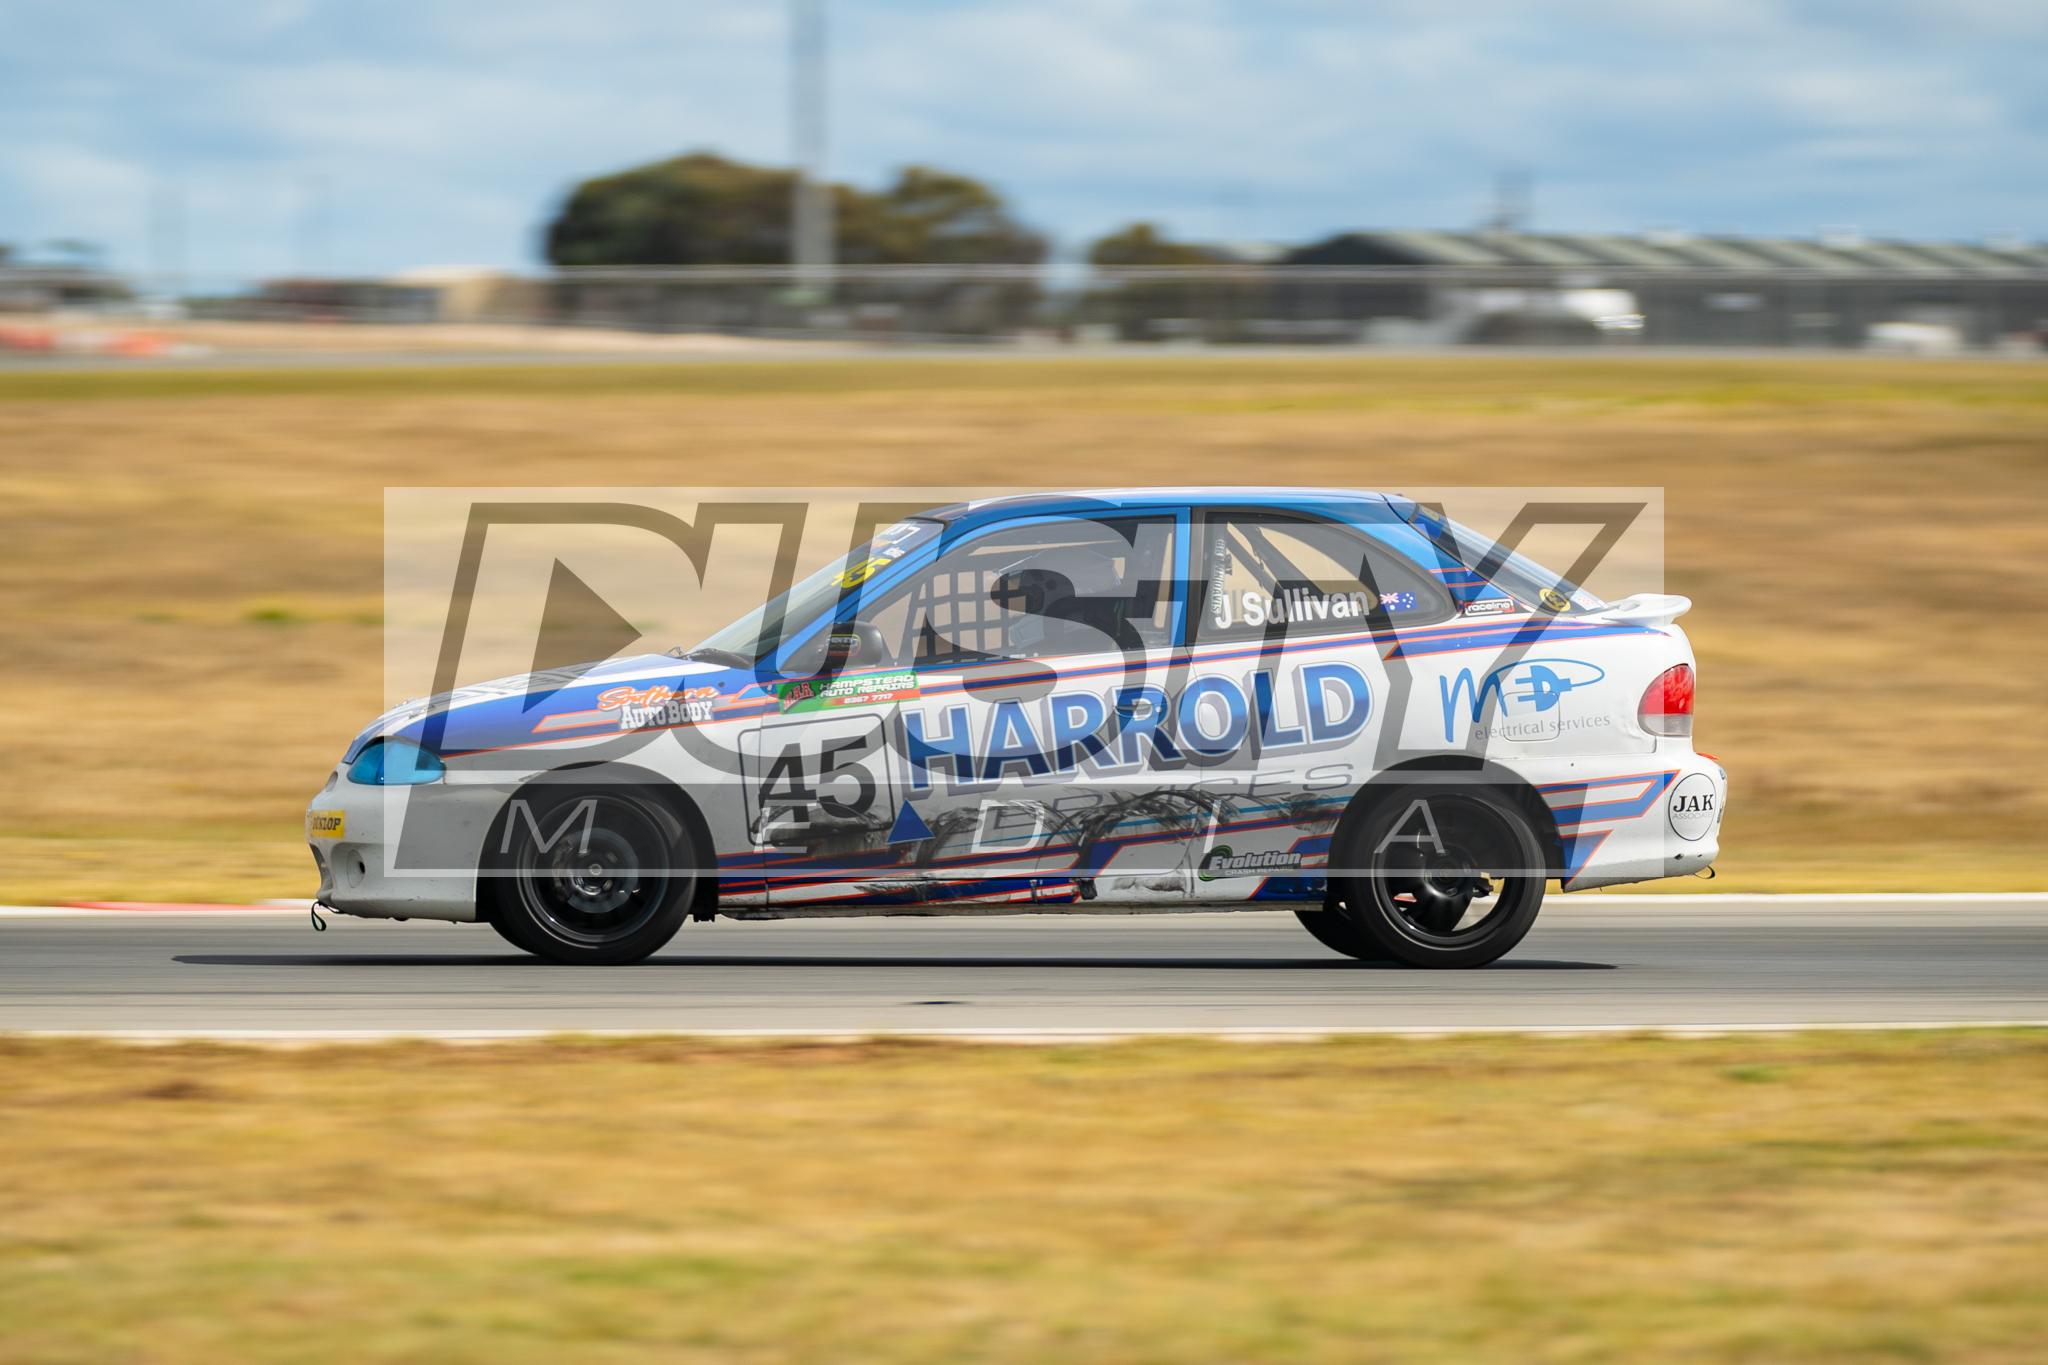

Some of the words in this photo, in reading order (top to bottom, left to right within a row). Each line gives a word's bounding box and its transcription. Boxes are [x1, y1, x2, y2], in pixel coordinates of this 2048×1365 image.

[1215, 594, 1232, 630] J
[1242, 587, 1370, 627] Sullivan
[820, 674, 915, 690] HAMPSTEAD
[820, 687, 854, 698] AUTO
[856, 681, 915, 695] REPAIRS
[597, 685, 720, 711] Southern
[902, 660, 1375, 800] HARROLD
[1474, 719, 1545, 741] electrical
[1549, 714, 1611, 732] services
[758, 735, 876, 824] 45
[1673, 794, 1714, 813] JAK
[311, 816, 342, 831] DUNLOP
[1208, 850, 1302, 871] Evolution
